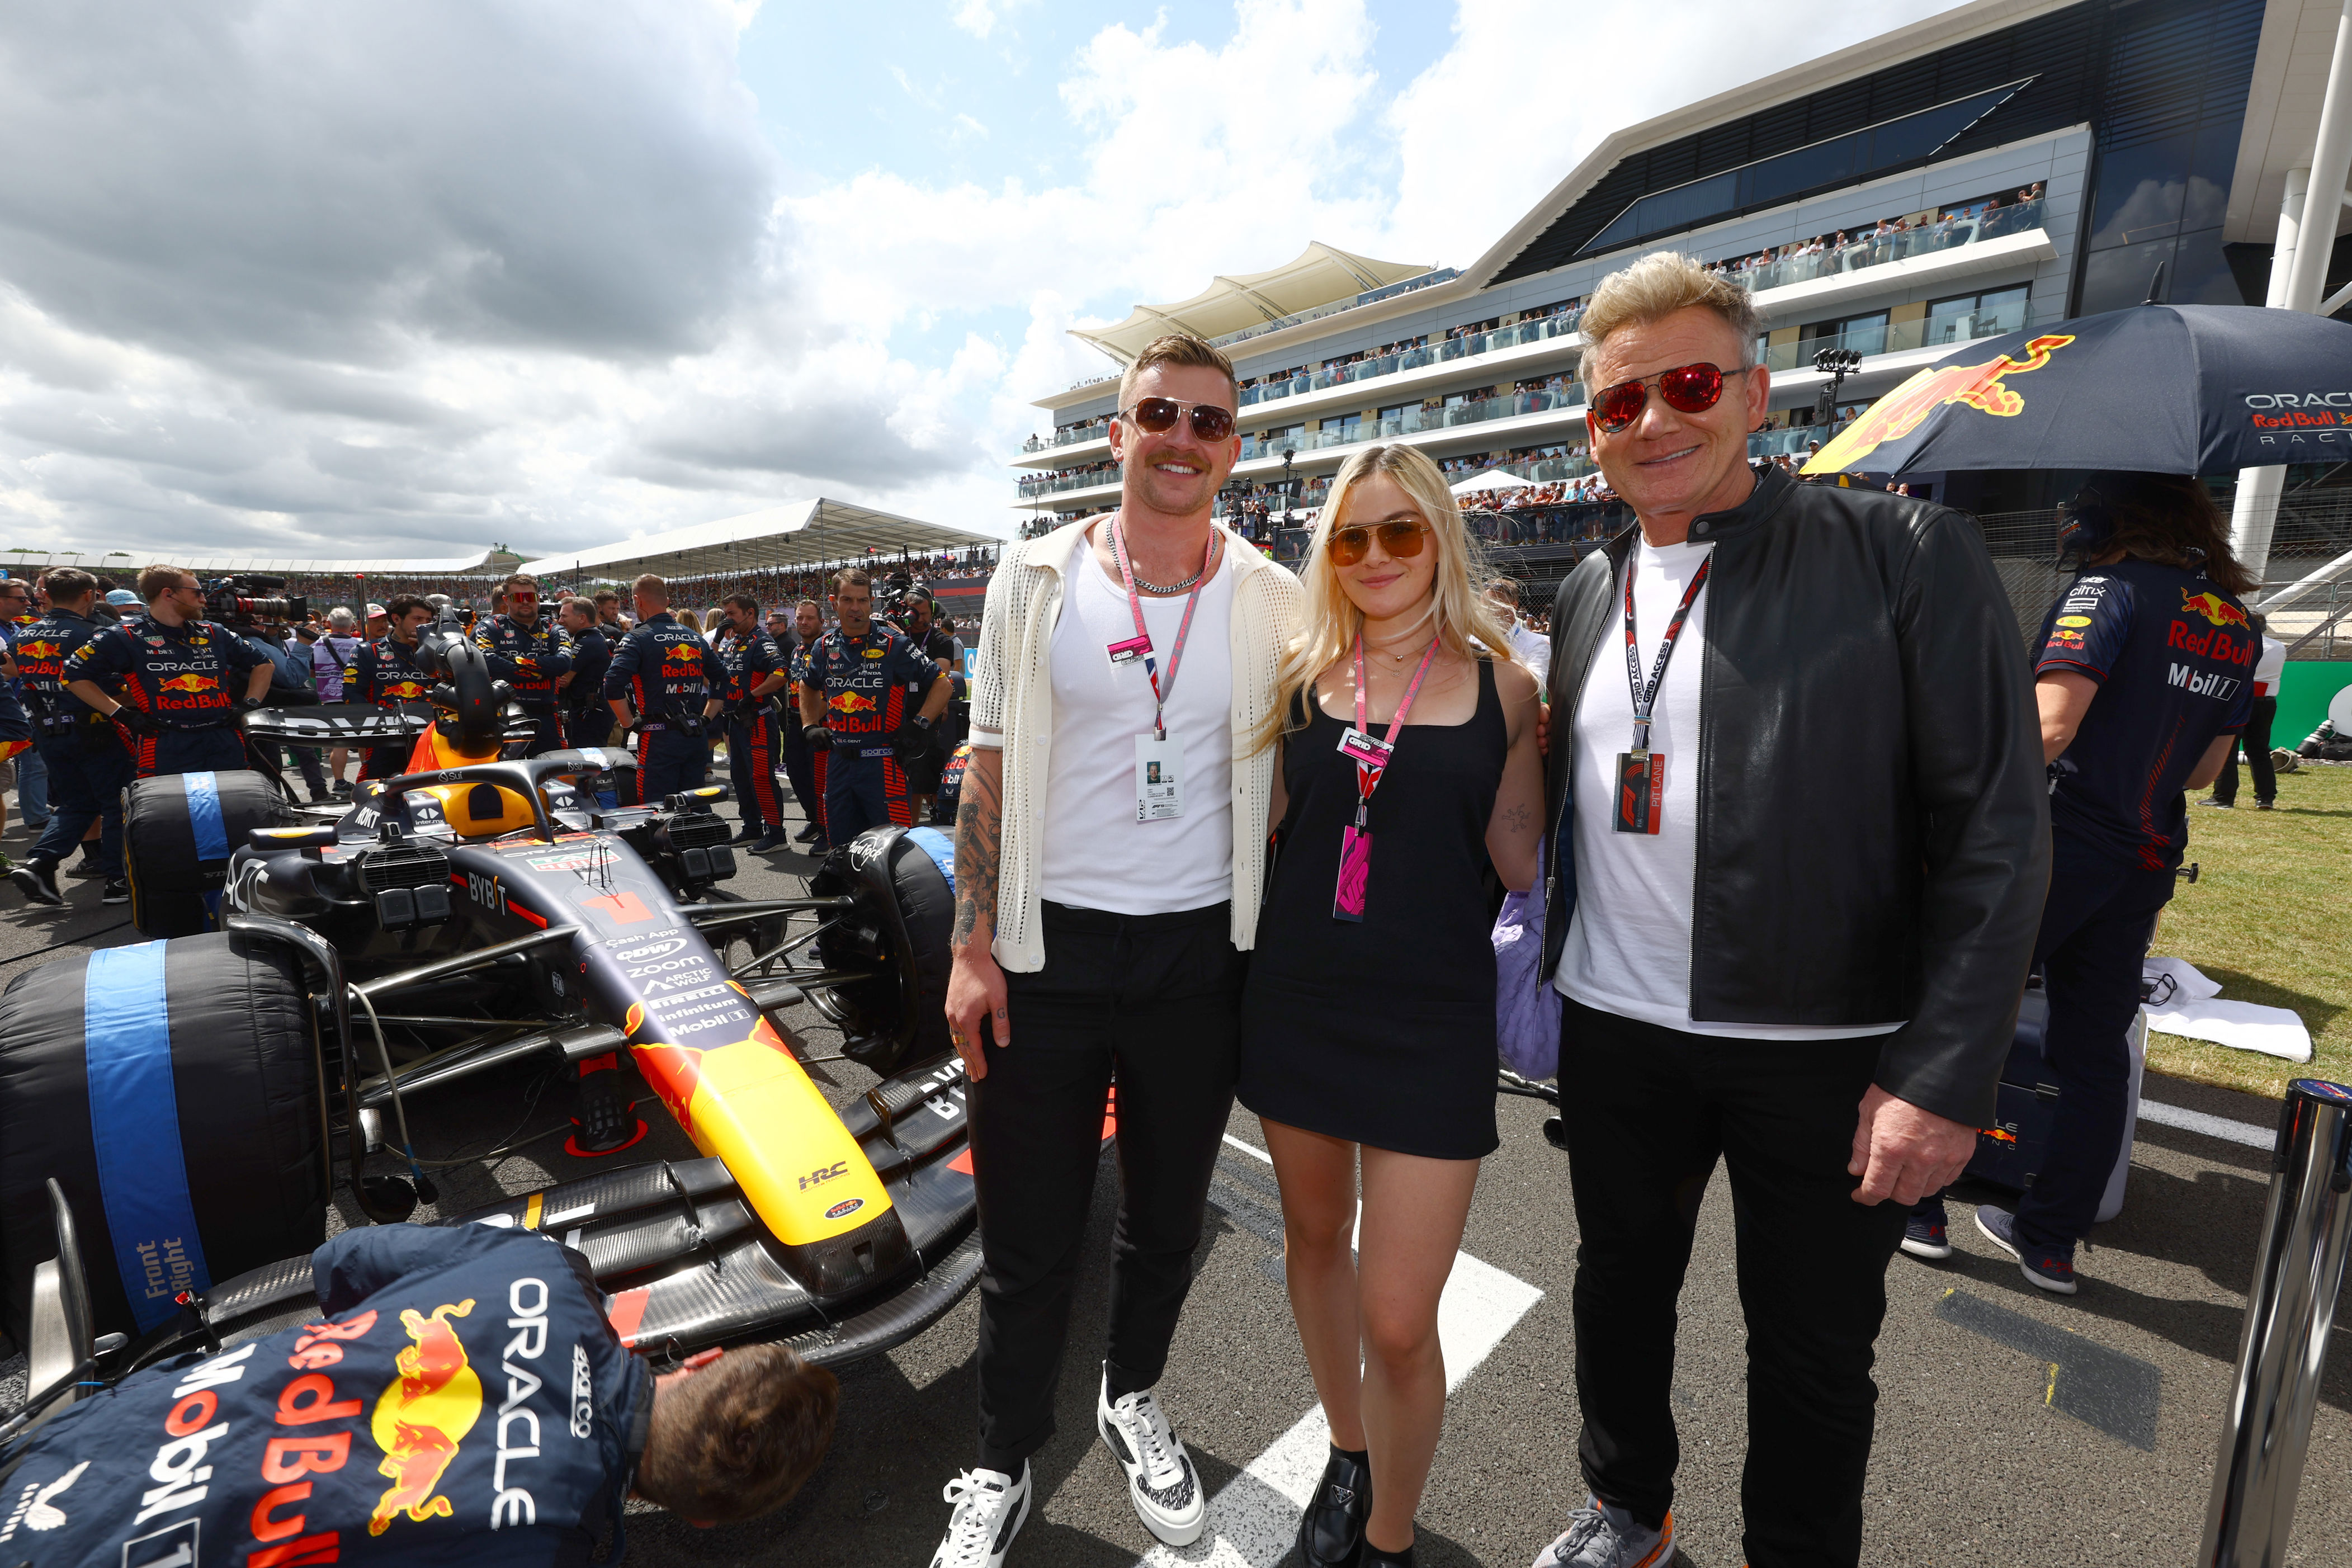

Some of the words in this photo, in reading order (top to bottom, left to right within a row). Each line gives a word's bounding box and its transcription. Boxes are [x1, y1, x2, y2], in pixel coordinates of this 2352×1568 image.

[2245, 392, 2352, 409] ORAC
[2251, 412, 2294, 428] Red
[2293, 411, 2336, 426] Bull
[2070, 585, 2107, 597] citrix
[18, 629, 72, 637] ORACLE
[654, 633, 700, 643] ORACLE
[2046, 640, 2063, 649] Red
[2064, 641, 2085, 650] Bull
[2167, 620, 2216, 657] Red
[2211, 632, 2255, 668] Bull
[1112, 650, 1133, 661] GRID
[1629, 646, 1640, 680] ACCESS
[147, 661, 219, 671] ORACLE
[662, 663, 687, 678] Red
[1643, 680, 1655, 703] GRID
[1651, 641, 1669, 679] ACCESS
[665, 683, 697, 694] Mobil
[825, 677, 884, 688] ORACLE
[2167, 662, 2220, 696] Mobil
[156, 694, 197, 710] Red
[1633, 682, 1643, 703] GRID
[849, 715, 882, 733] Bull
[1385, 720, 1401, 744] GREAT
[1397, 695, 1413, 722] BRITAIN
[861, 747, 893, 755] sparco
[1348, 736, 1371, 750] GRID
[449, 772, 463, 781] Sui
[1652, 761, 1663, 789] LANE
[1651, 791, 1660, 807] PIT
[355, 806, 381, 829] ROKT
[539, 849, 610, 862] TAG
[848, 840, 865, 856] Hard
[862, 843, 884, 862] Rock
[540, 856, 616, 871] HEUER
[468, 871, 506, 916] BYBIT
[581, 891, 654, 925] 1
[606, 934, 645, 947] Cash
[649, 928, 679, 939] App
[616, 942, 673, 961] CDW
[665, 967, 712, 984] ARCTIC
[673, 973, 712, 988] WOLF
[648, 984, 728, 1010] PIRELLI
[667, 1013, 729, 1037] Mobil
[798, 1160, 848, 1191] HRC
[136, 1240, 168, 1299] Front
[163, 1237, 194, 1292] Right
[275, 1310, 378, 1426] Red
[570, 1344, 593, 1439] sparco
[490, 1277, 549, 1530] ORACLE
[135, 1343, 256, 1526] Mobil
